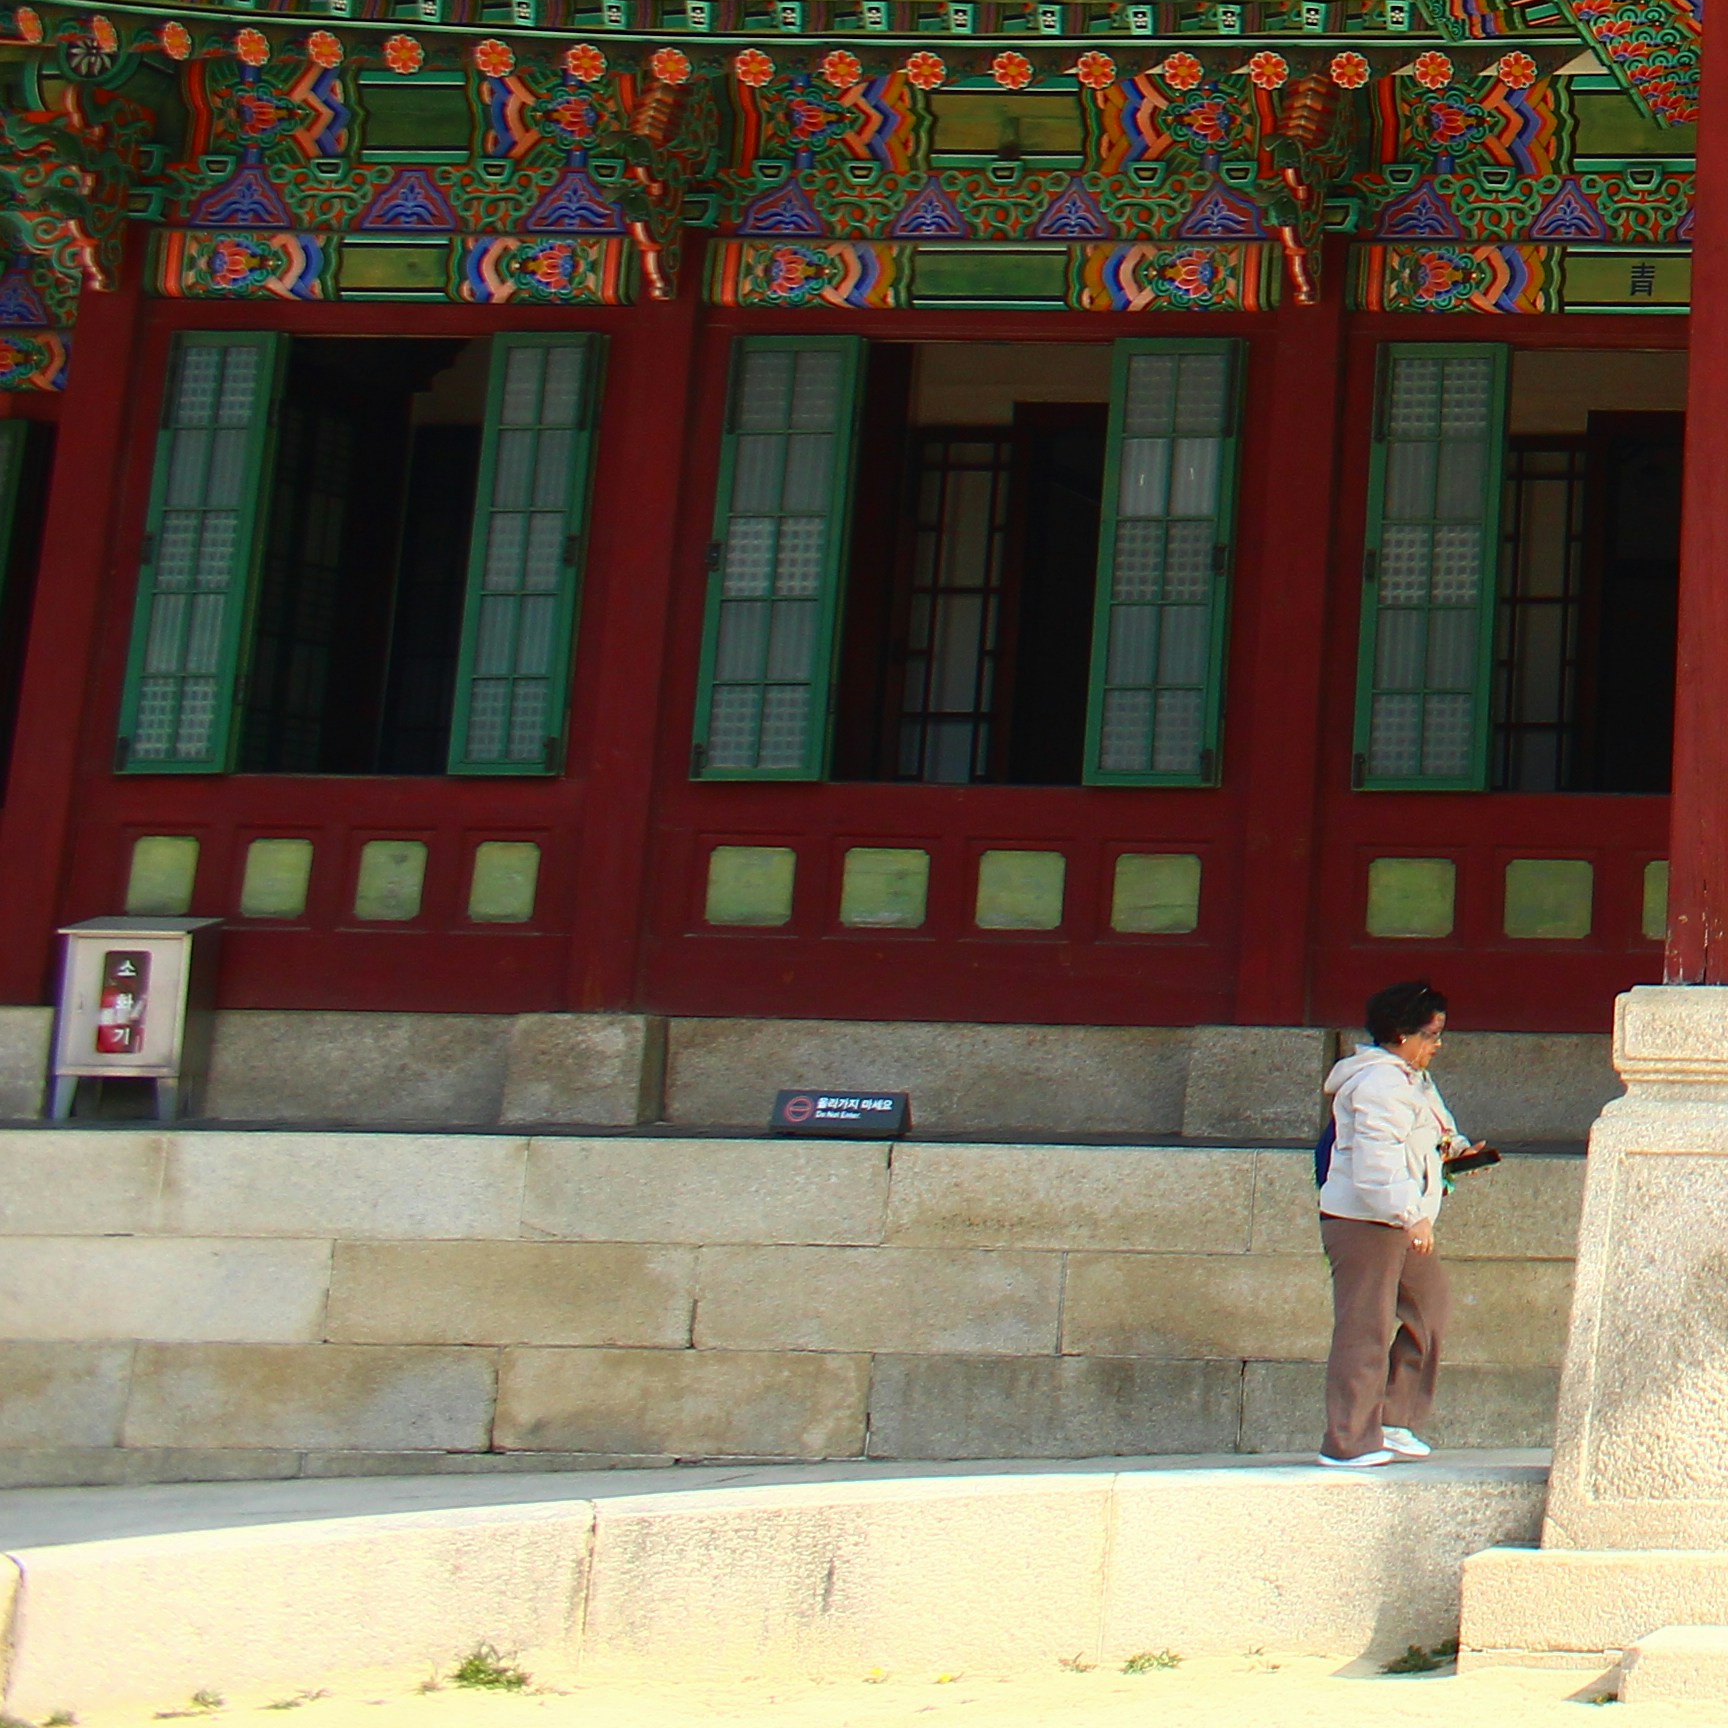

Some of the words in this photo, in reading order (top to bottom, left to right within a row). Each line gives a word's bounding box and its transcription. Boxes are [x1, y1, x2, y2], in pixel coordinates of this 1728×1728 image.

[112, 959, 136, 1045] 소화기
[816, 1097, 860, 1110] 올라가지
[861, 1099, 893, 1111] 마세요
